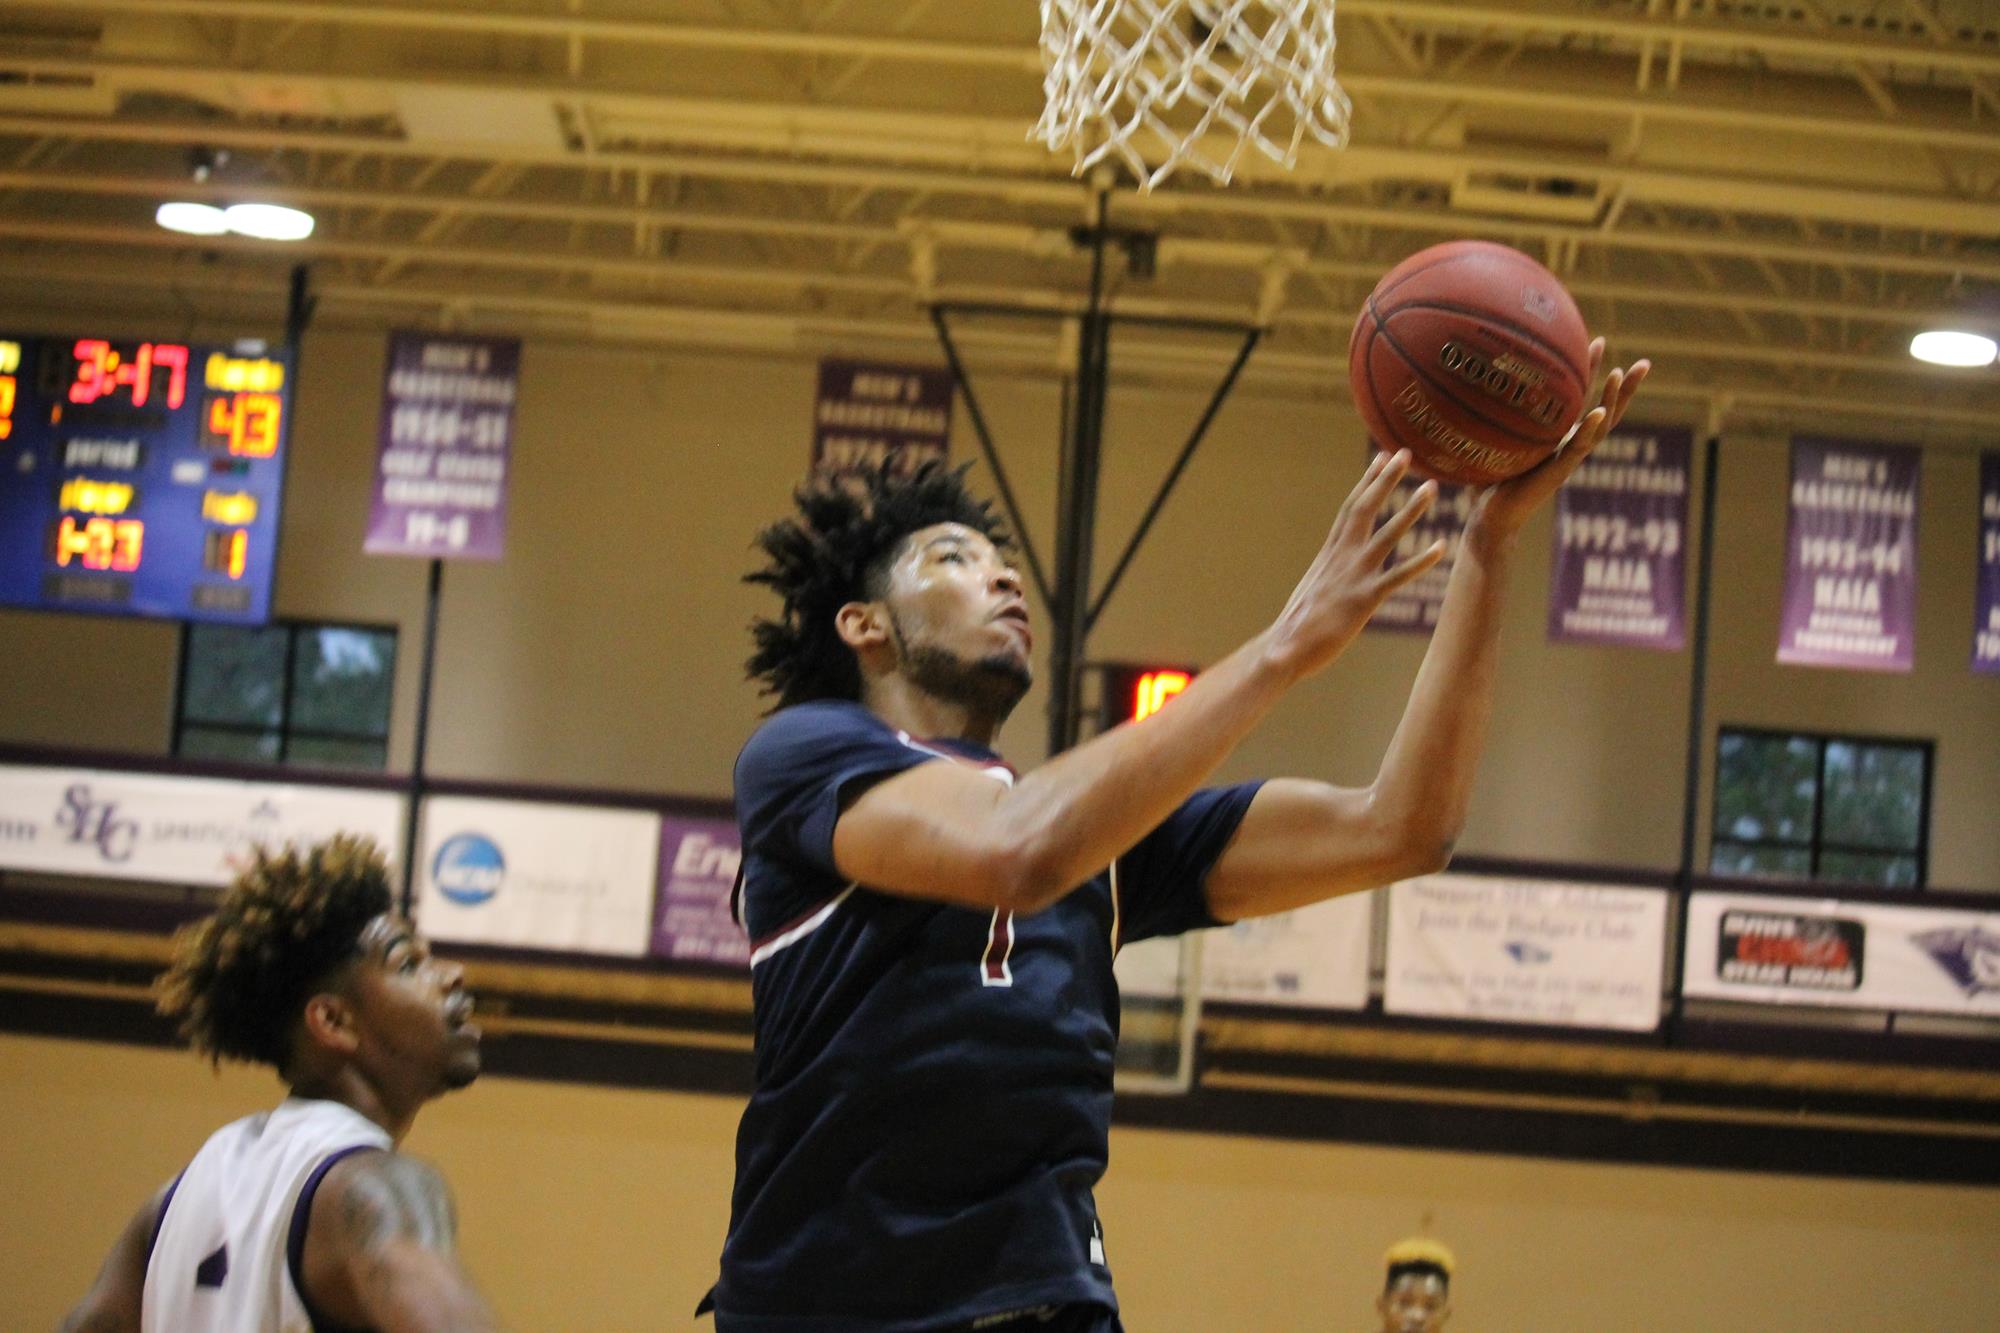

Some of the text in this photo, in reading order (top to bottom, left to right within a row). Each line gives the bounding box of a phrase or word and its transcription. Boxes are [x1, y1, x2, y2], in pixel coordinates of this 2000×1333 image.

[209, 391, 282, 459] 43
[1583, 556, 1652, 592] NAIA
[1813, 574, 1880, 613] NAIA
